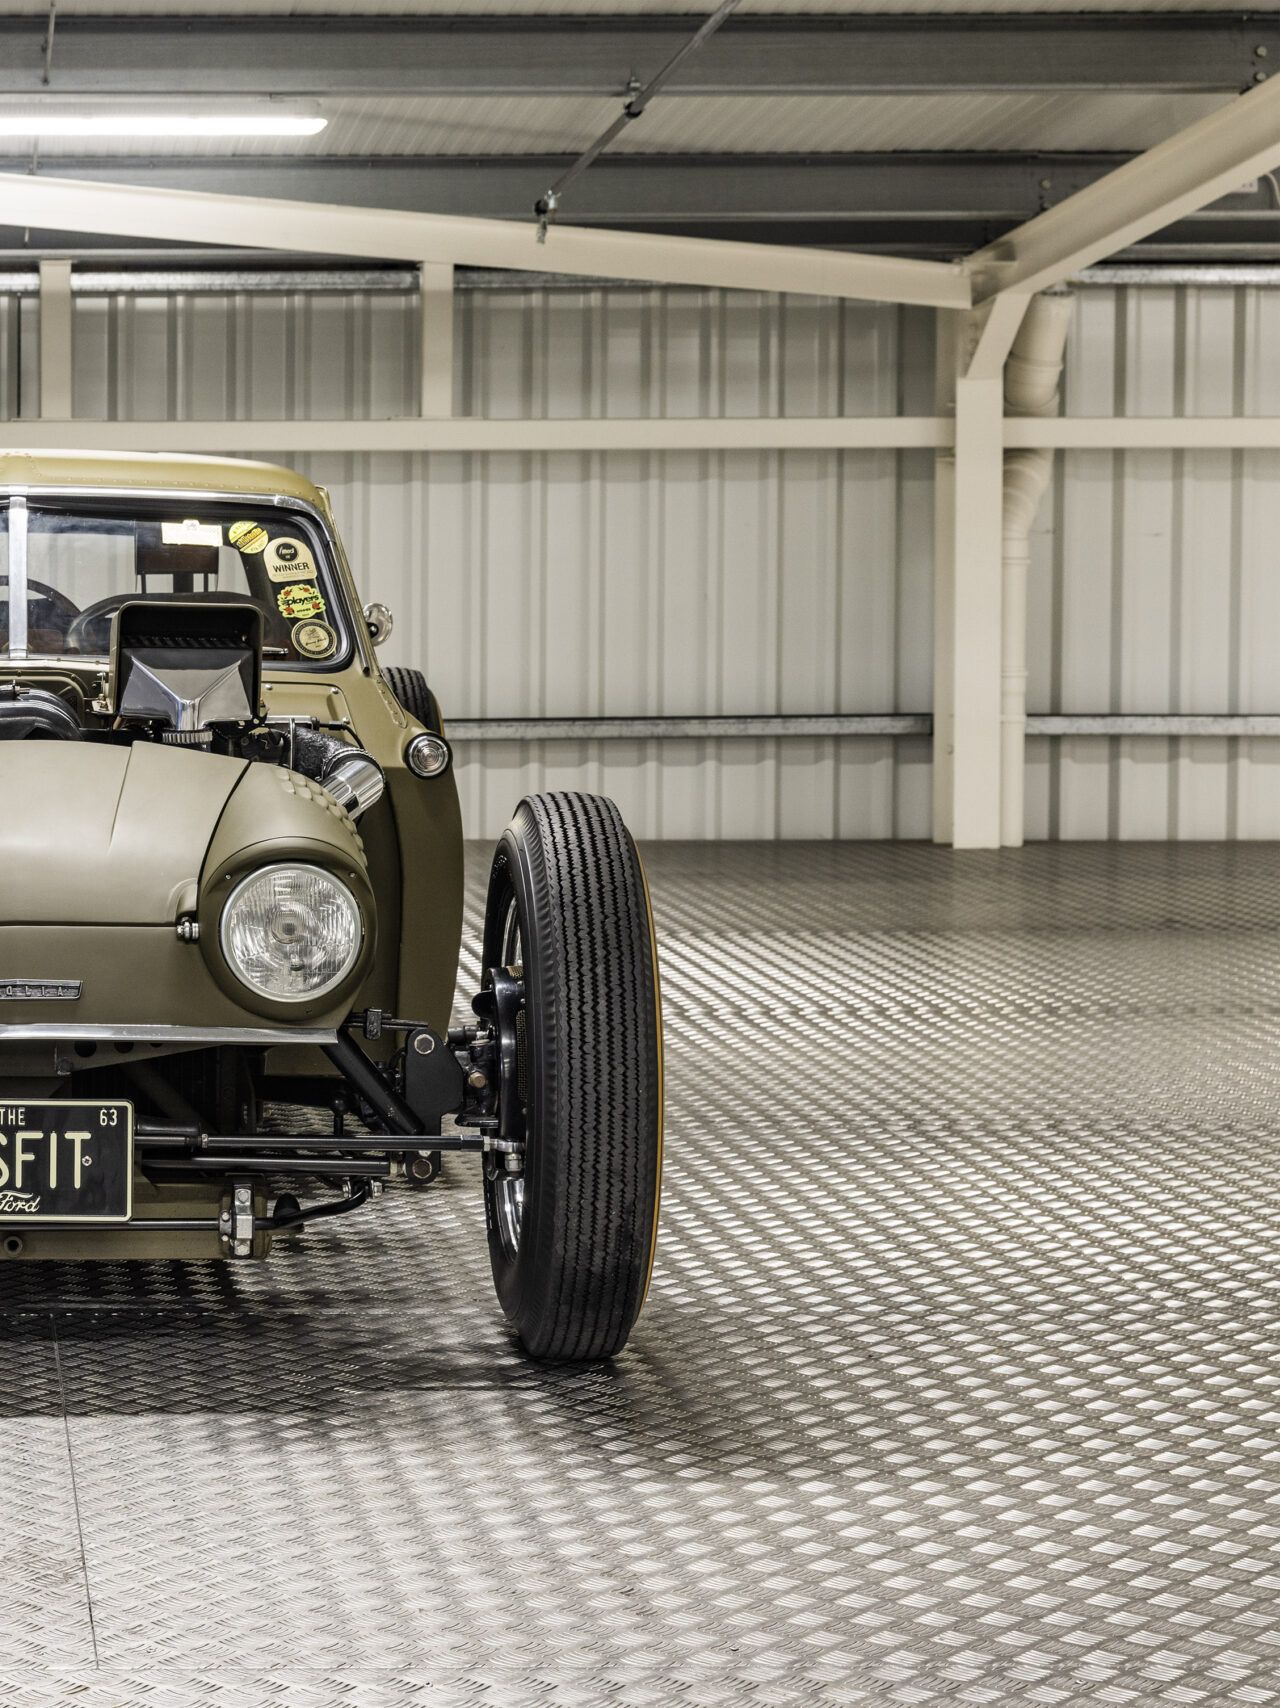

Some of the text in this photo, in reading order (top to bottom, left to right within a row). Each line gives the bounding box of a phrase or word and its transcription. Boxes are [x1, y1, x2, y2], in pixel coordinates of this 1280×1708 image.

[272, 562, 310, 573] WINNER
[286, 594, 319, 607] players
[99, 1108, 118, 1126] 63
